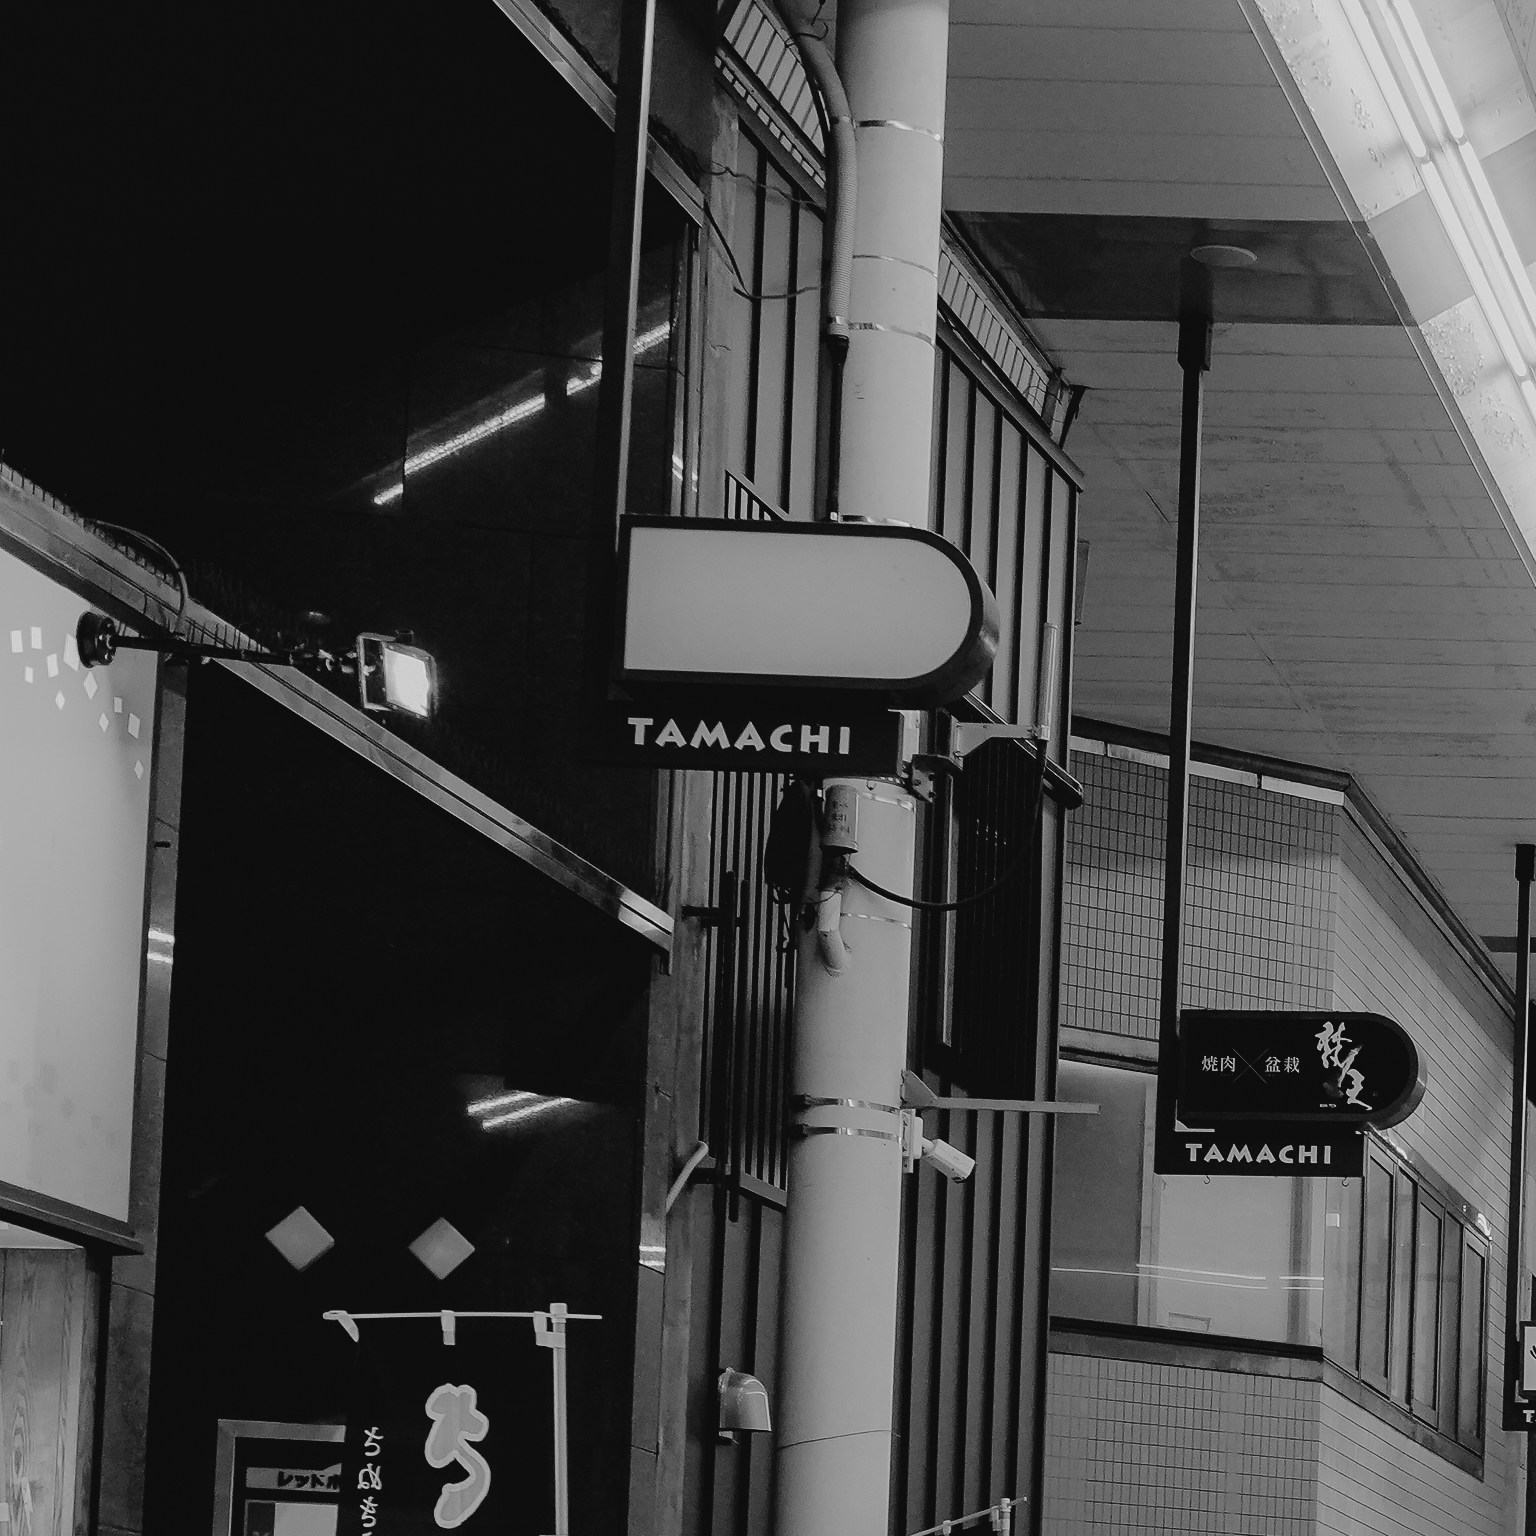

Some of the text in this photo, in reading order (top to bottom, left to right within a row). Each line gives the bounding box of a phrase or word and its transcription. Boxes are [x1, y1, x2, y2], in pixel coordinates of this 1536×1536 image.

[627, 716, 851, 755] TAMACHI
[1201, 1055, 1236, 1073] 焼肉
[1264, 1055, 1300, 1074] 盆栽
[1185, 1143, 1332, 1165] TAMACHI
